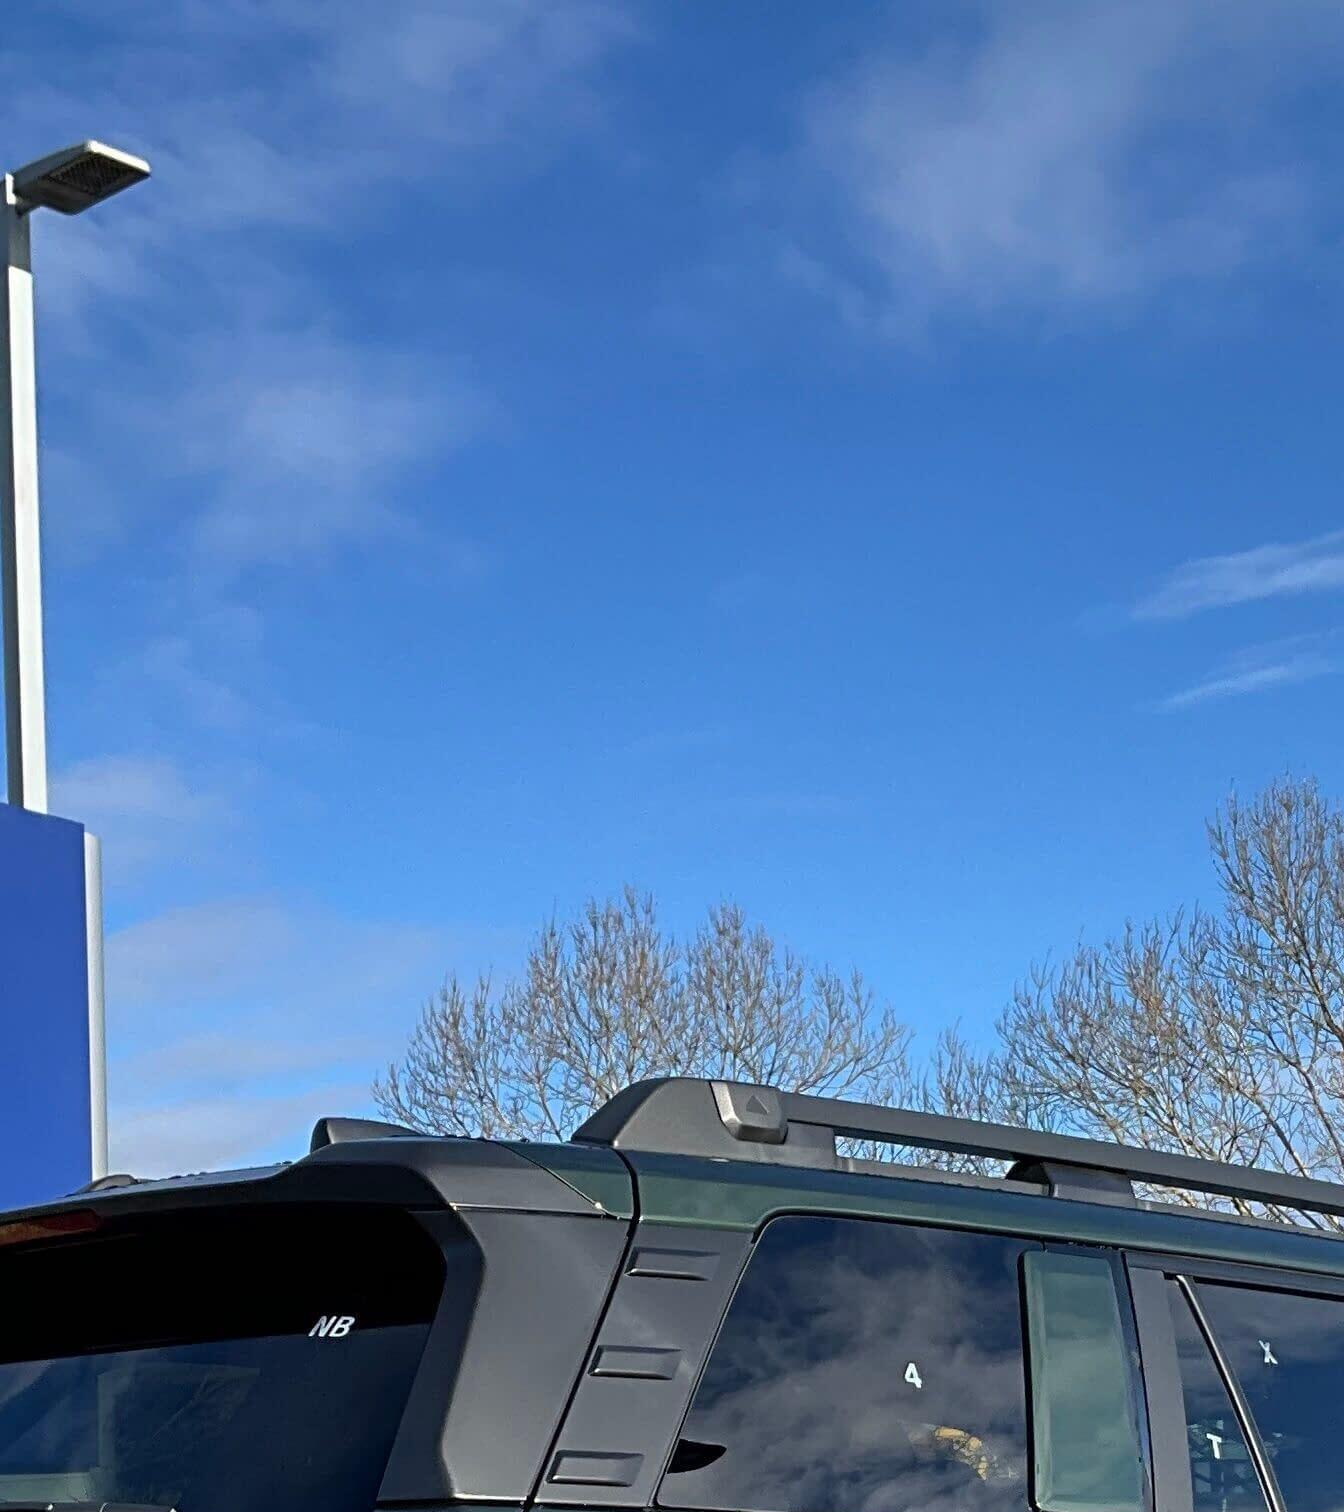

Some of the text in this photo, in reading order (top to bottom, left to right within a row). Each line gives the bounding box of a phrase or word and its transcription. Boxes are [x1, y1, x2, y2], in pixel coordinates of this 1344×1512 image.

[308, 1315, 356, 1338] NB
[1259, 1340, 1278, 1365] X
[905, 1362, 922, 1389] 4
[1207, 1433, 1222, 1459] T
